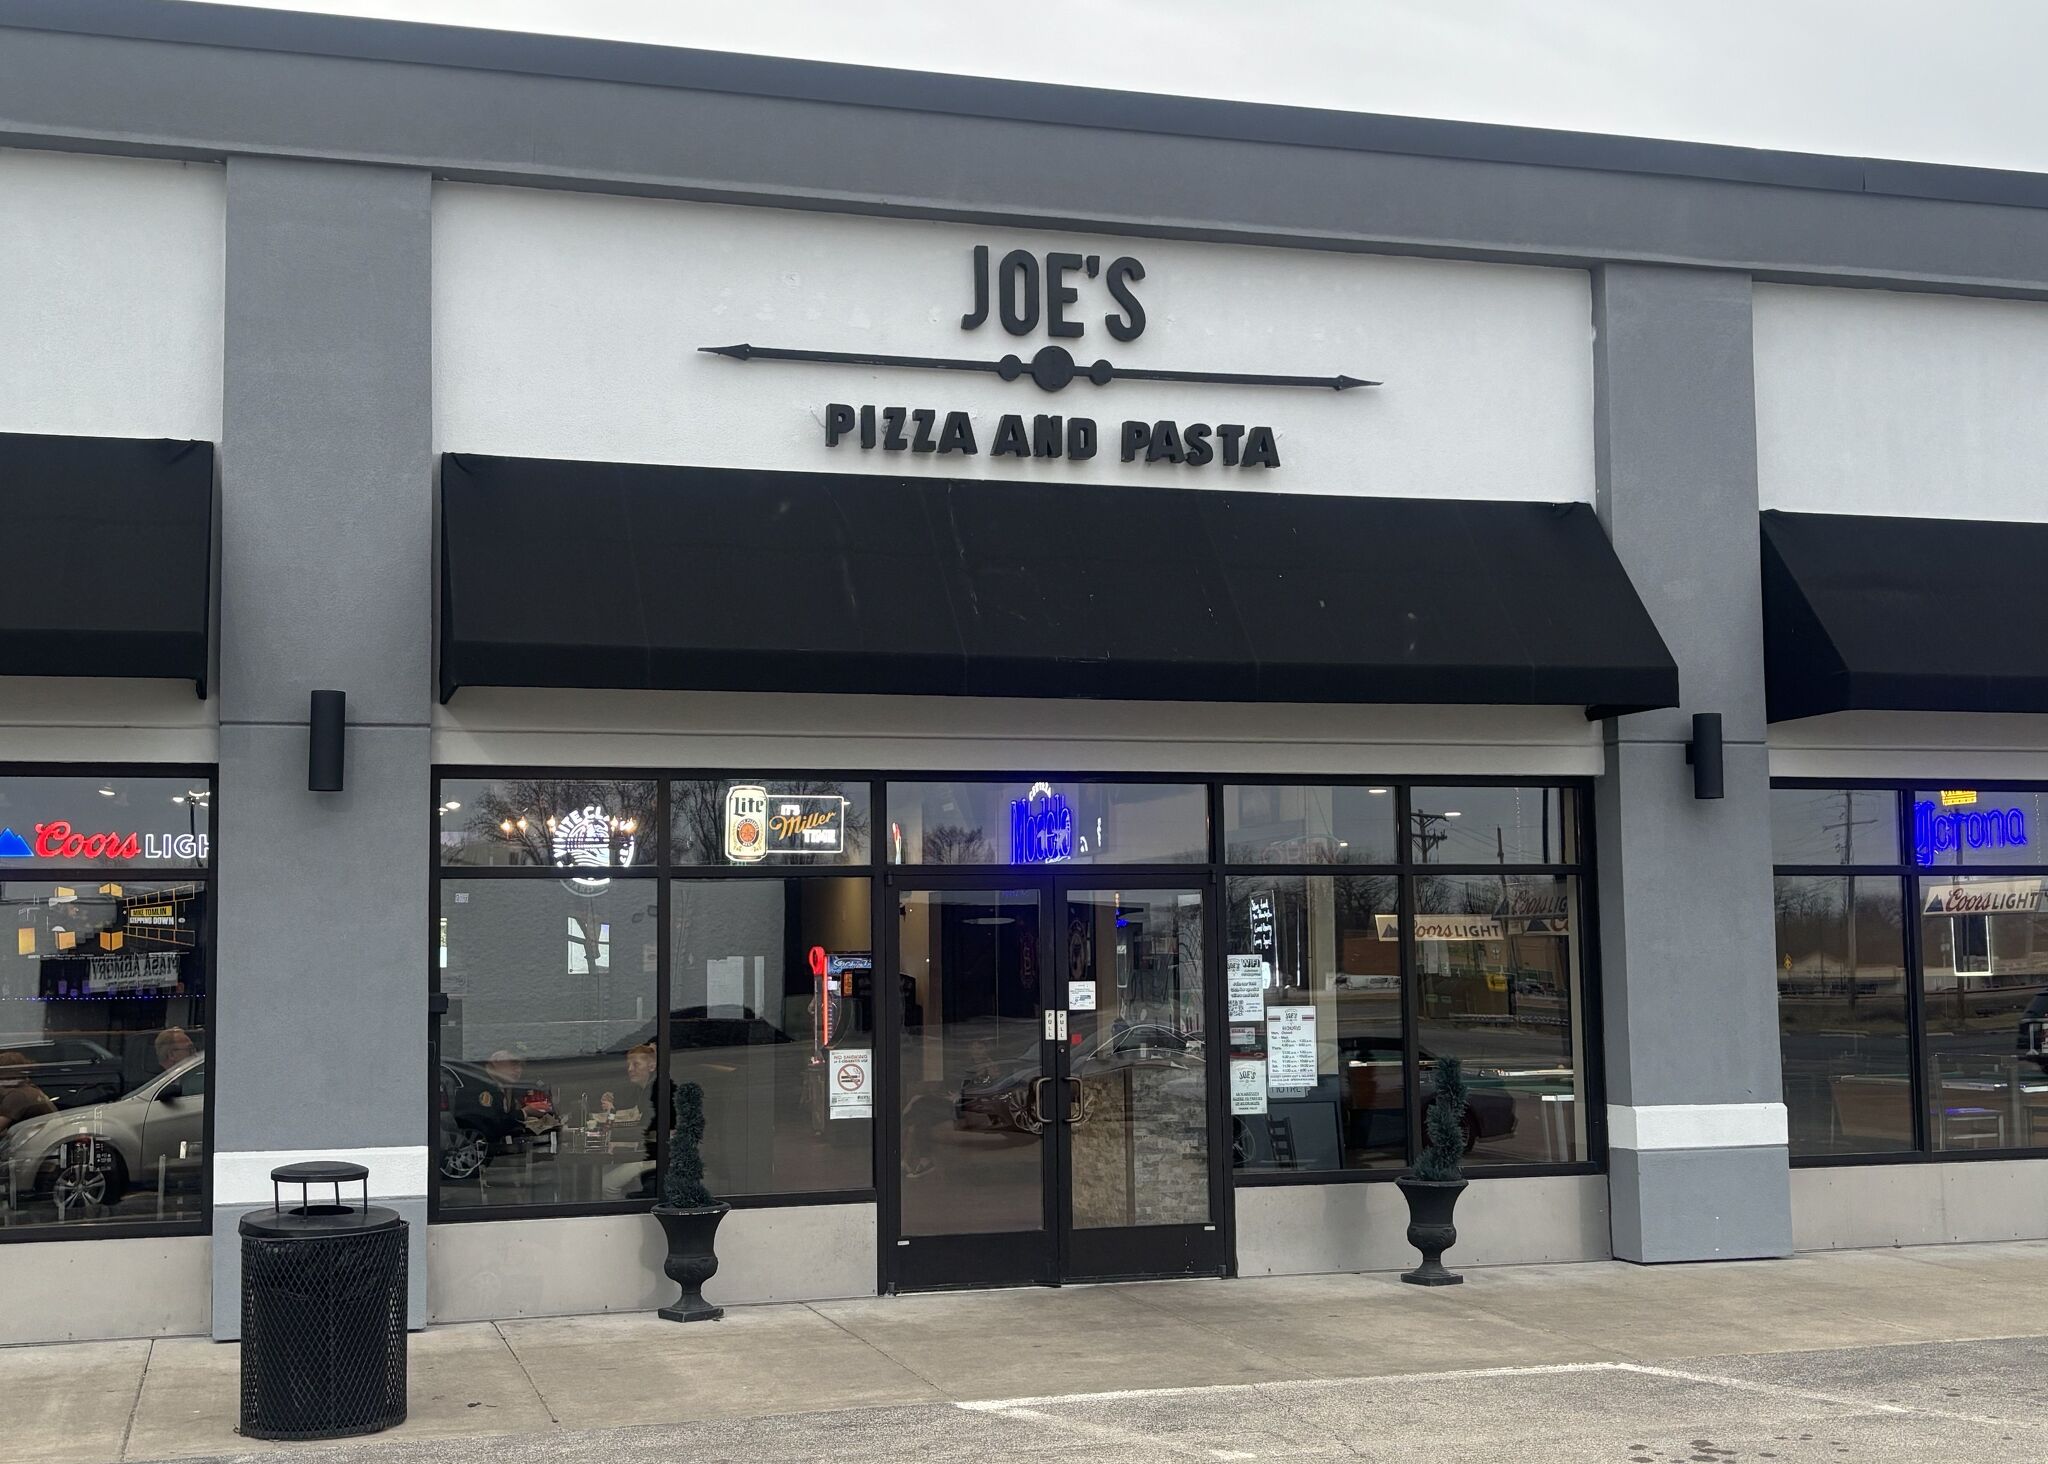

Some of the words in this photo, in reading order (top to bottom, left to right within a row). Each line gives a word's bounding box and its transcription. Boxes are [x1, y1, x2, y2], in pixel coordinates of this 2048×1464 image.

[961, 245, 1146, 342] JOE'S
[826, 403, 978, 455] PIZZA
[990, 414, 1097, 460] AND
[1120, 421, 1281, 468] PASTA
[734, 797, 764, 817] Lite
[769, 811, 837, 841] Miller
[1011, 793, 1071, 865] Modelo
[1914, 801, 2027, 866] Corona
[34, 820, 141, 859] Coors
[145, 833, 209, 859] LIGH
[145, 907, 167, 915] TOMLIN
[1550, 897, 1568, 914] LIG
[1945, 888, 1990, 912] Coors
[1992, 892, 2039, 910] LIGHT
[153, 917, 174, 925] DOWN
[1415, 920, 1452, 938] oors
[1456, 925, 1499, 937] LIGHT
[1239, 1070, 1257, 1080] JOE'S
